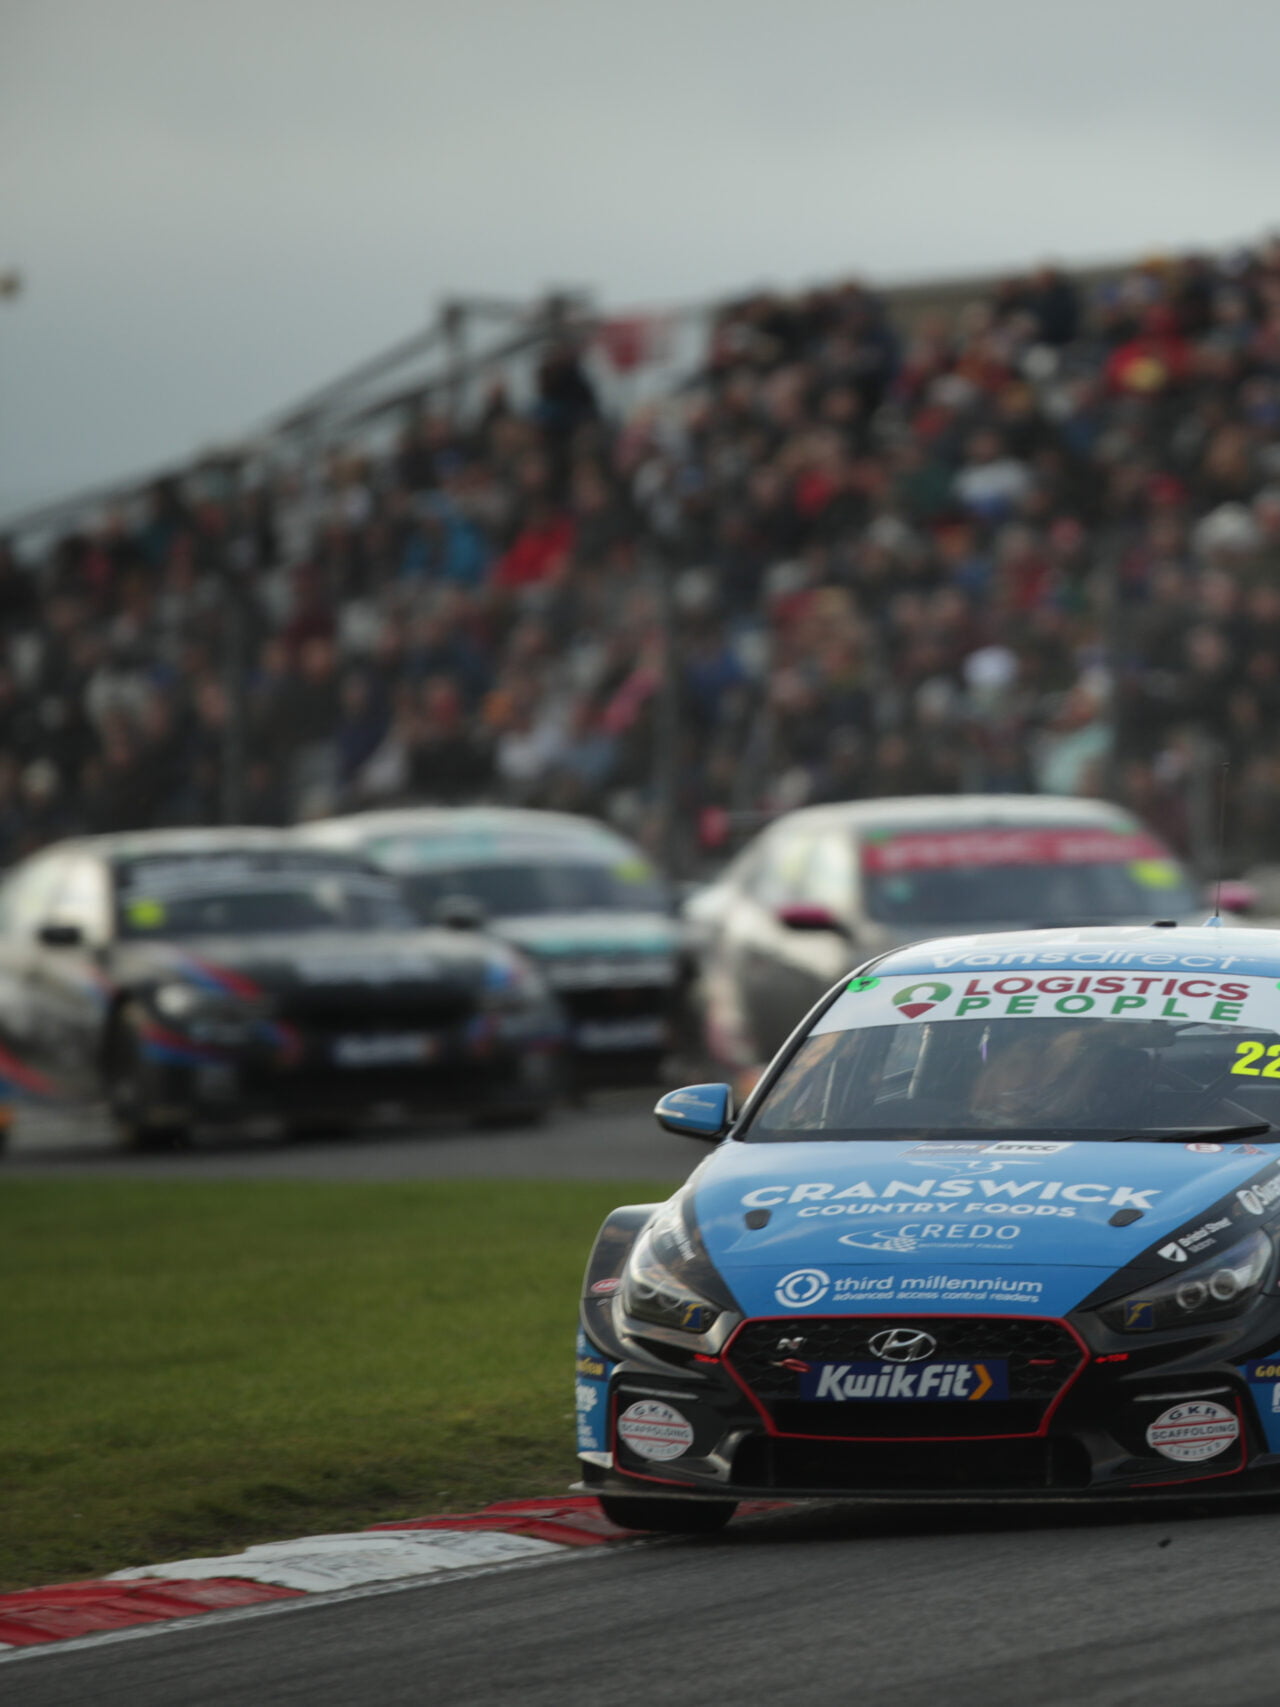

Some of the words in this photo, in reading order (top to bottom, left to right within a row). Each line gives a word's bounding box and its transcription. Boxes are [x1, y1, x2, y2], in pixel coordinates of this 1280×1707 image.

[963, 975, 1251, 1001] LOGISTICS
[955, 993, 1245, 1022] PEOPLE
[739, 1178, 1163, 1210] CRANSWICK
[796, 1202, 960, 1218] COUNTRY
[963, 1202, 1078, 1218] FOODS
[898, 1223, 1022, 1241] CREDO
[833, 1275, 895, 1291] third
[901, 1274, 1043, 1293] millennium
[1151, 1423, 1236, 1440] SCAFFOLDING
